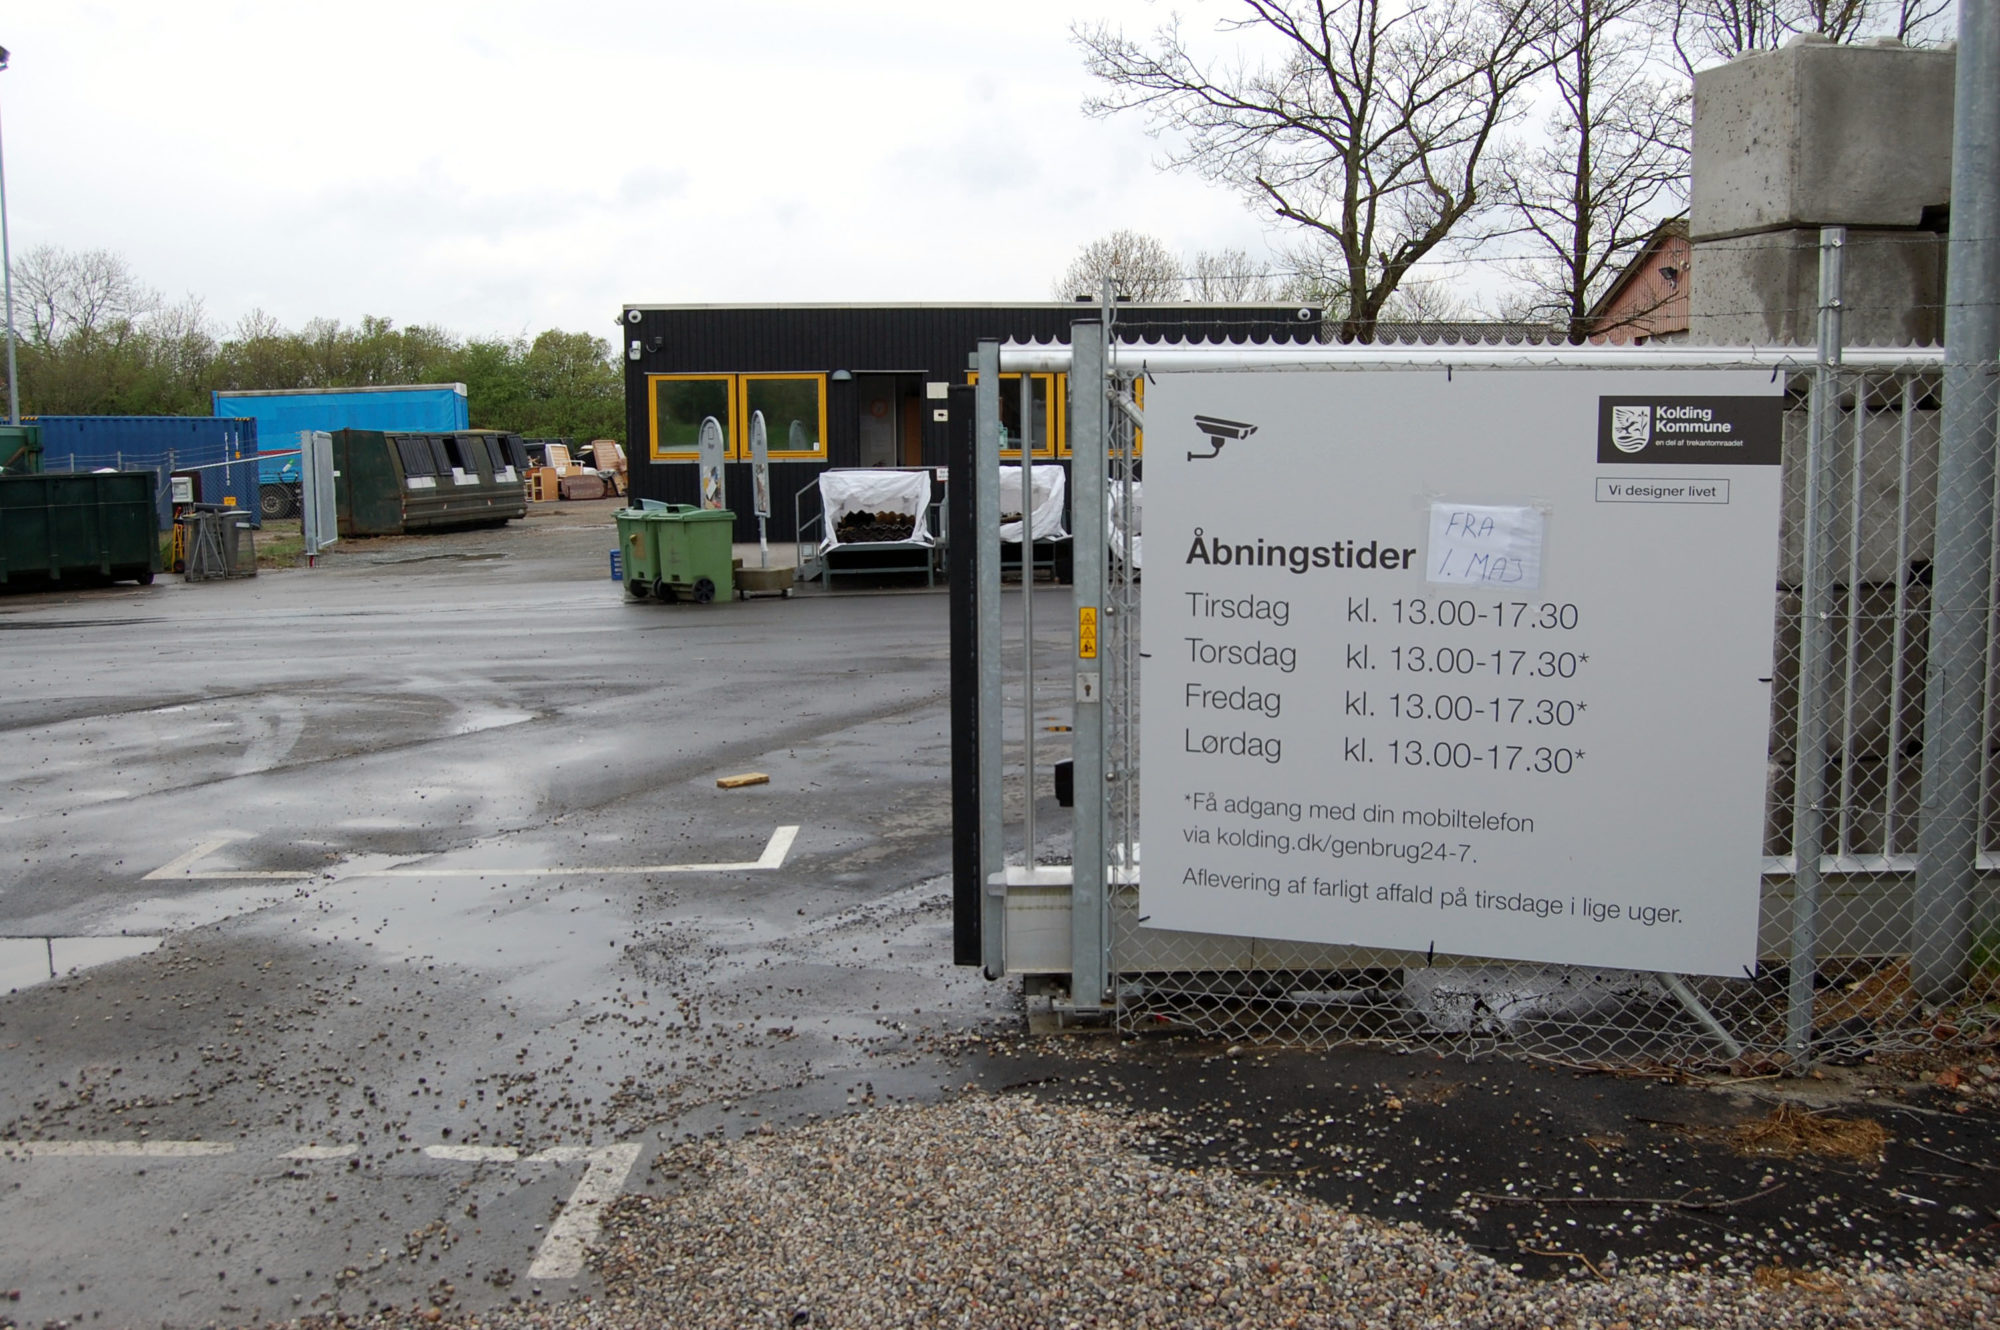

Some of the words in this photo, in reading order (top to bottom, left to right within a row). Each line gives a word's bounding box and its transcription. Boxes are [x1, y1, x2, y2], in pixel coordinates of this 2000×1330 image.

[1656, 406, 1712, 421] Kolding
[1656, 420, 1731, 432] Kommune
[1608, 485, 1622, 496] Vi
[1625, 485, 1685, 499] designer
[1688, 486, 1716, 497] livet
[1445, 512, 1495, 538] FRA
[1185, 527, 1417, 575] Åbningstider
[1465, 553, 1523, 583] MAJ
[1184, 592, 1290, 627] Tirsdag
[1347, 597, 1377, 623] kl.
[1391, 599, 1579, 631] 13.00-17.30
[1183, 638, 1297, 674] Torsdag
[1346, 643, 1376, 671] kl.
[1185, 683, 1281, 719] Fredag
[1345, 690, 1375, 717] kl.
[1185, 728, 1282, 765] Lørdag
[1344, 737, 1374, 764] kl.
[1223, 796, 1302, 823] adgang
[1309, 803, 1356, 822] med
[1362, 804, 1395, 824] din
[1402, 808, 1534, 833] mobiltelefon
[1182, 825, 1211, 845] via
[1217, 828, 1478, 863] kolding.dk/genbrug24-7.
[1182, 867, 1281, 898] Aflevering
[1287, 876, 1308, 895] af
[1312, 877, 1369, 904] farligt
[1375, 883, 1433, 905] affald
[1440, 887, 1468, 910] på
[1474, 890, 1564, 919] tirsdage
[1570, 897, 1575, 916] i
[1583, 898, 1621, 923] lige
[1628, 906, 1683, 927] uger.
